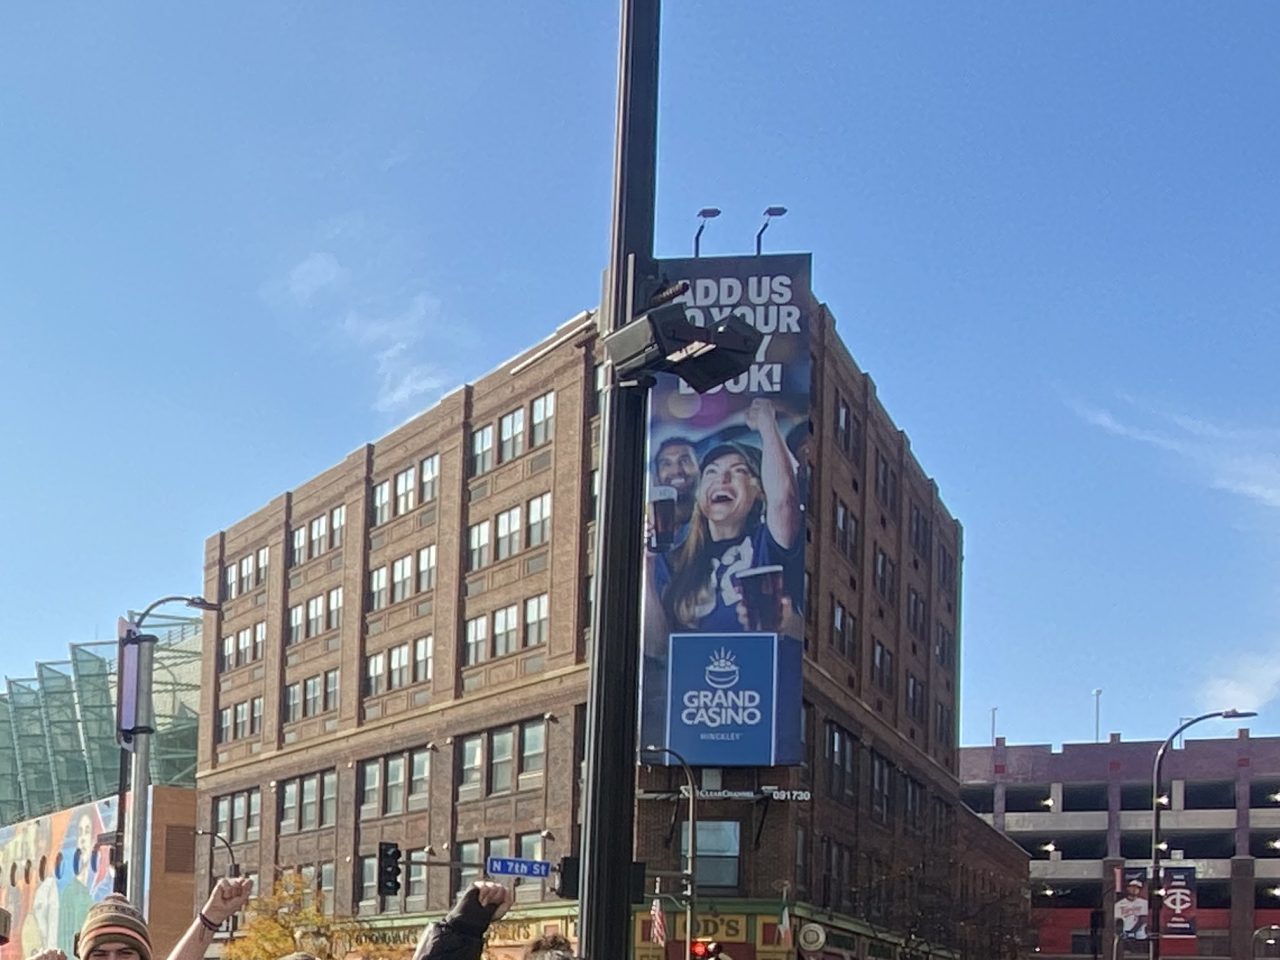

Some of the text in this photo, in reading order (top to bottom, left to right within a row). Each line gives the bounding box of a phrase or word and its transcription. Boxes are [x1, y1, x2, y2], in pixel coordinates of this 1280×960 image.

[672, 275, 792, 307] ADD US
[683, 689, 760, 708] GRAND
[681, 708, 761, 728] CASINO
[772, 790, 810, 800] 091730
[492, 862, 546, 876] N 7th St
